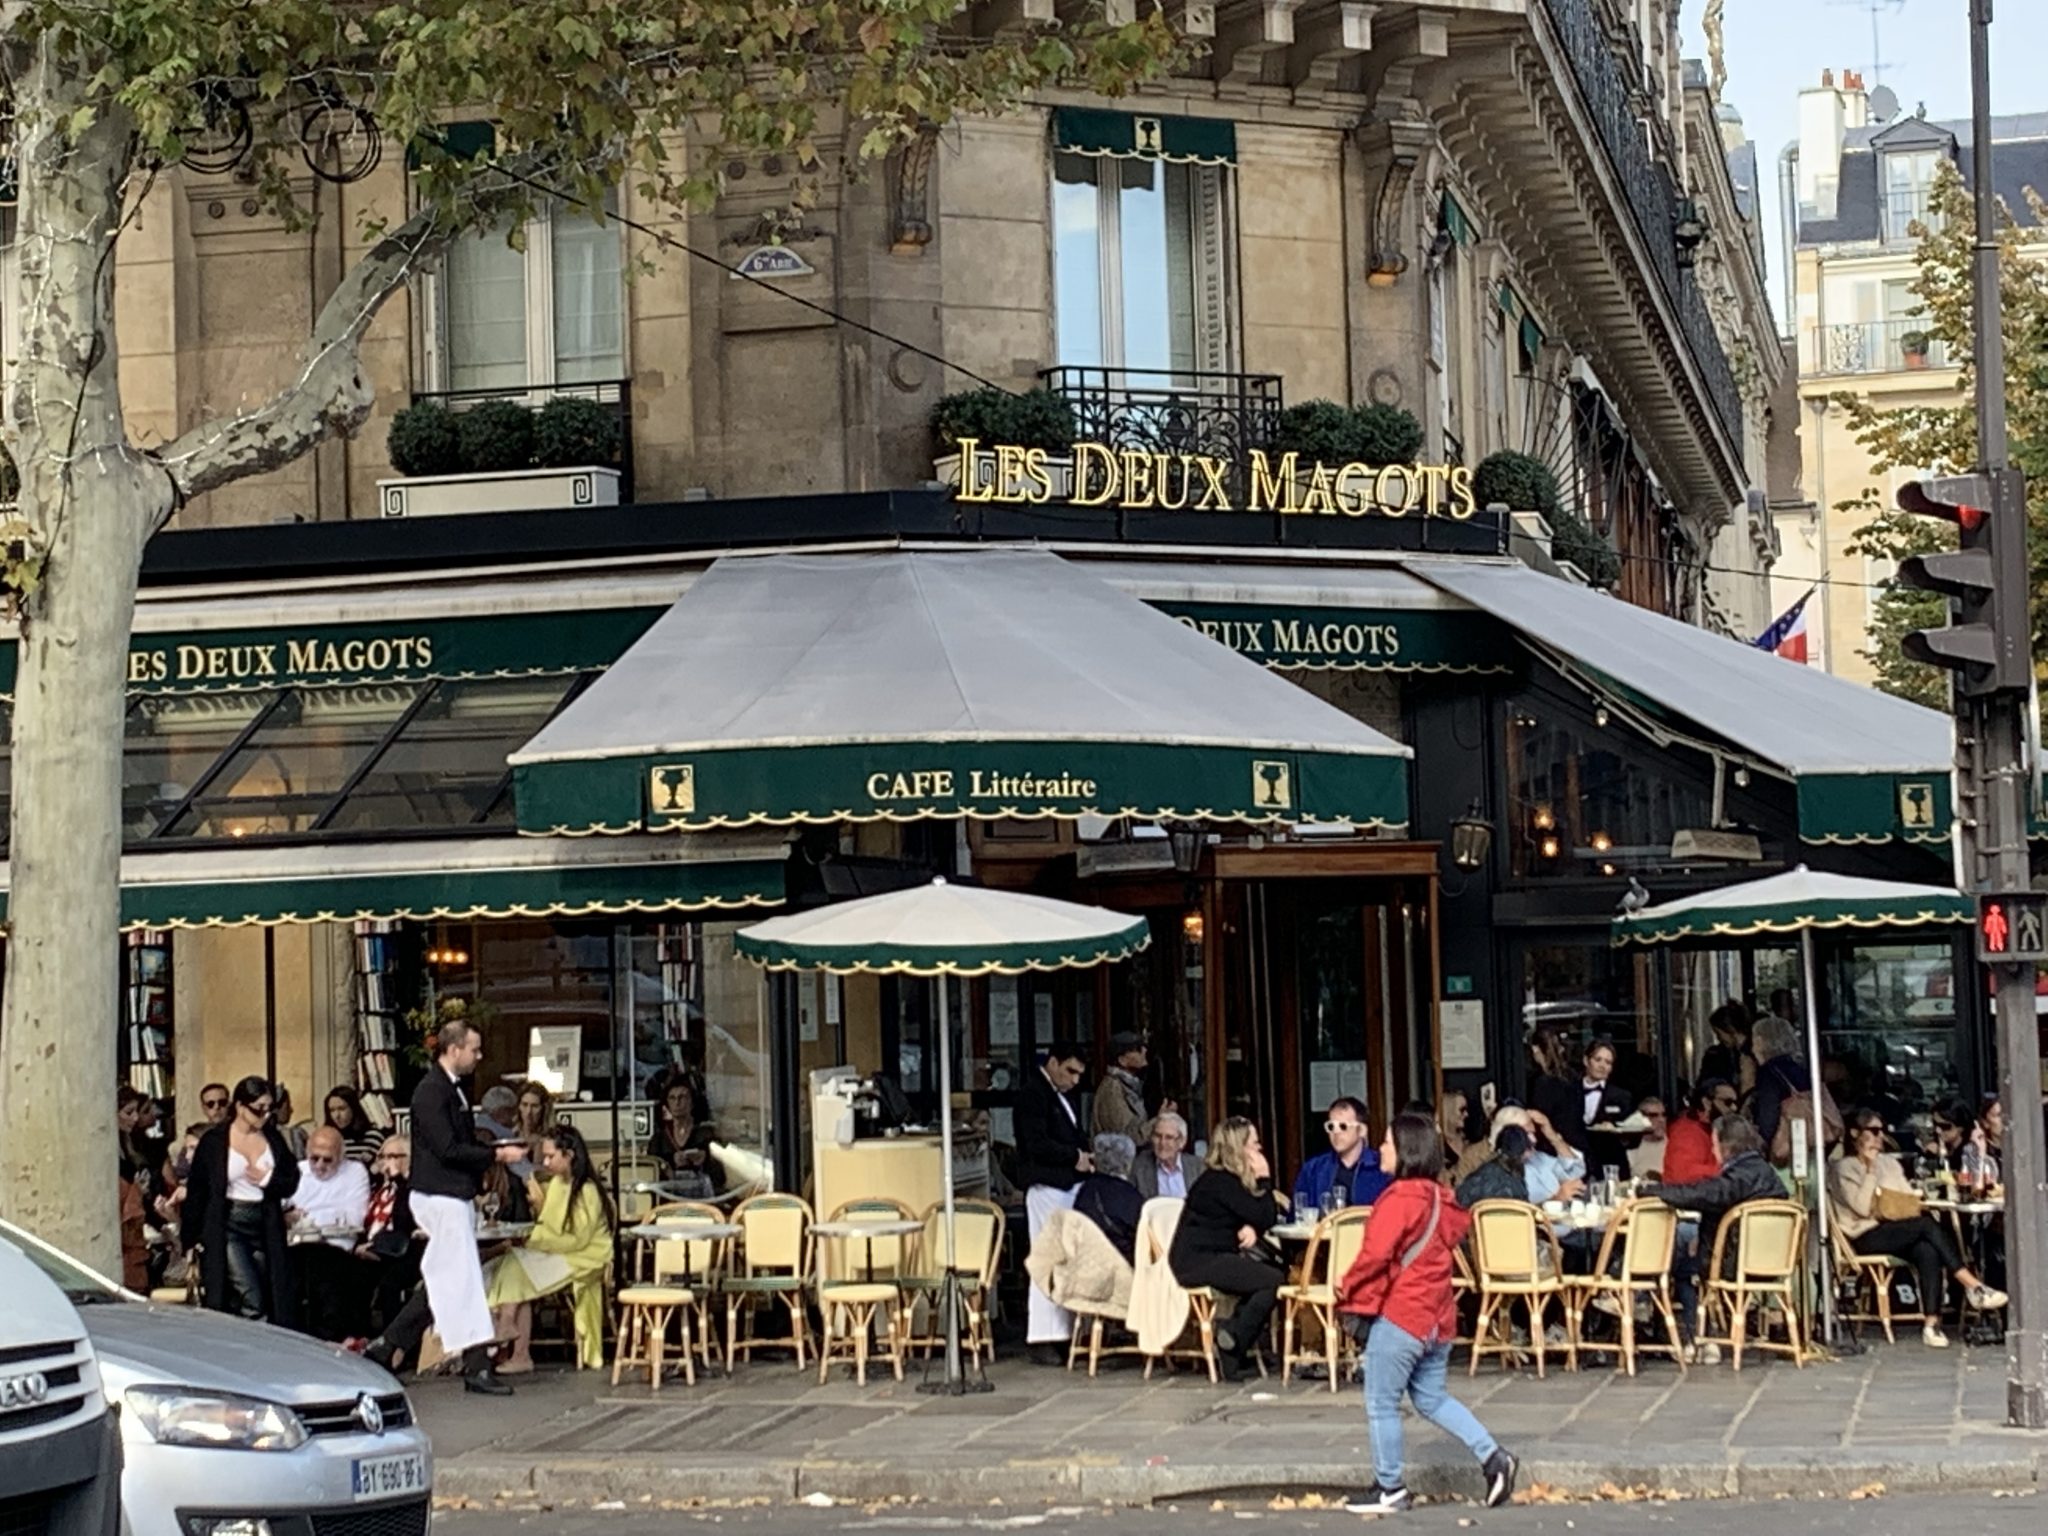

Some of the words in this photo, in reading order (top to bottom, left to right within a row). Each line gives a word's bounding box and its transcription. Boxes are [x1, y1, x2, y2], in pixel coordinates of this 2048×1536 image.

[956, 437, 1054, 504] LES
[1068, 443, 1233, 511] DEUX
[1248, 448, 1475, 519] MAGOTS
[1271, 619, 1400, 656] MAGOTS
[127, 650, 168, 682] ES
[176, 644, 278, 680] DEUX
[286, 636, 433, 674] MAGOTS
[866, 770, 955, 799] CAFE
[969, 770, 1097, 798] Littéraire
[0, 1372, 48, 1407] ECO
